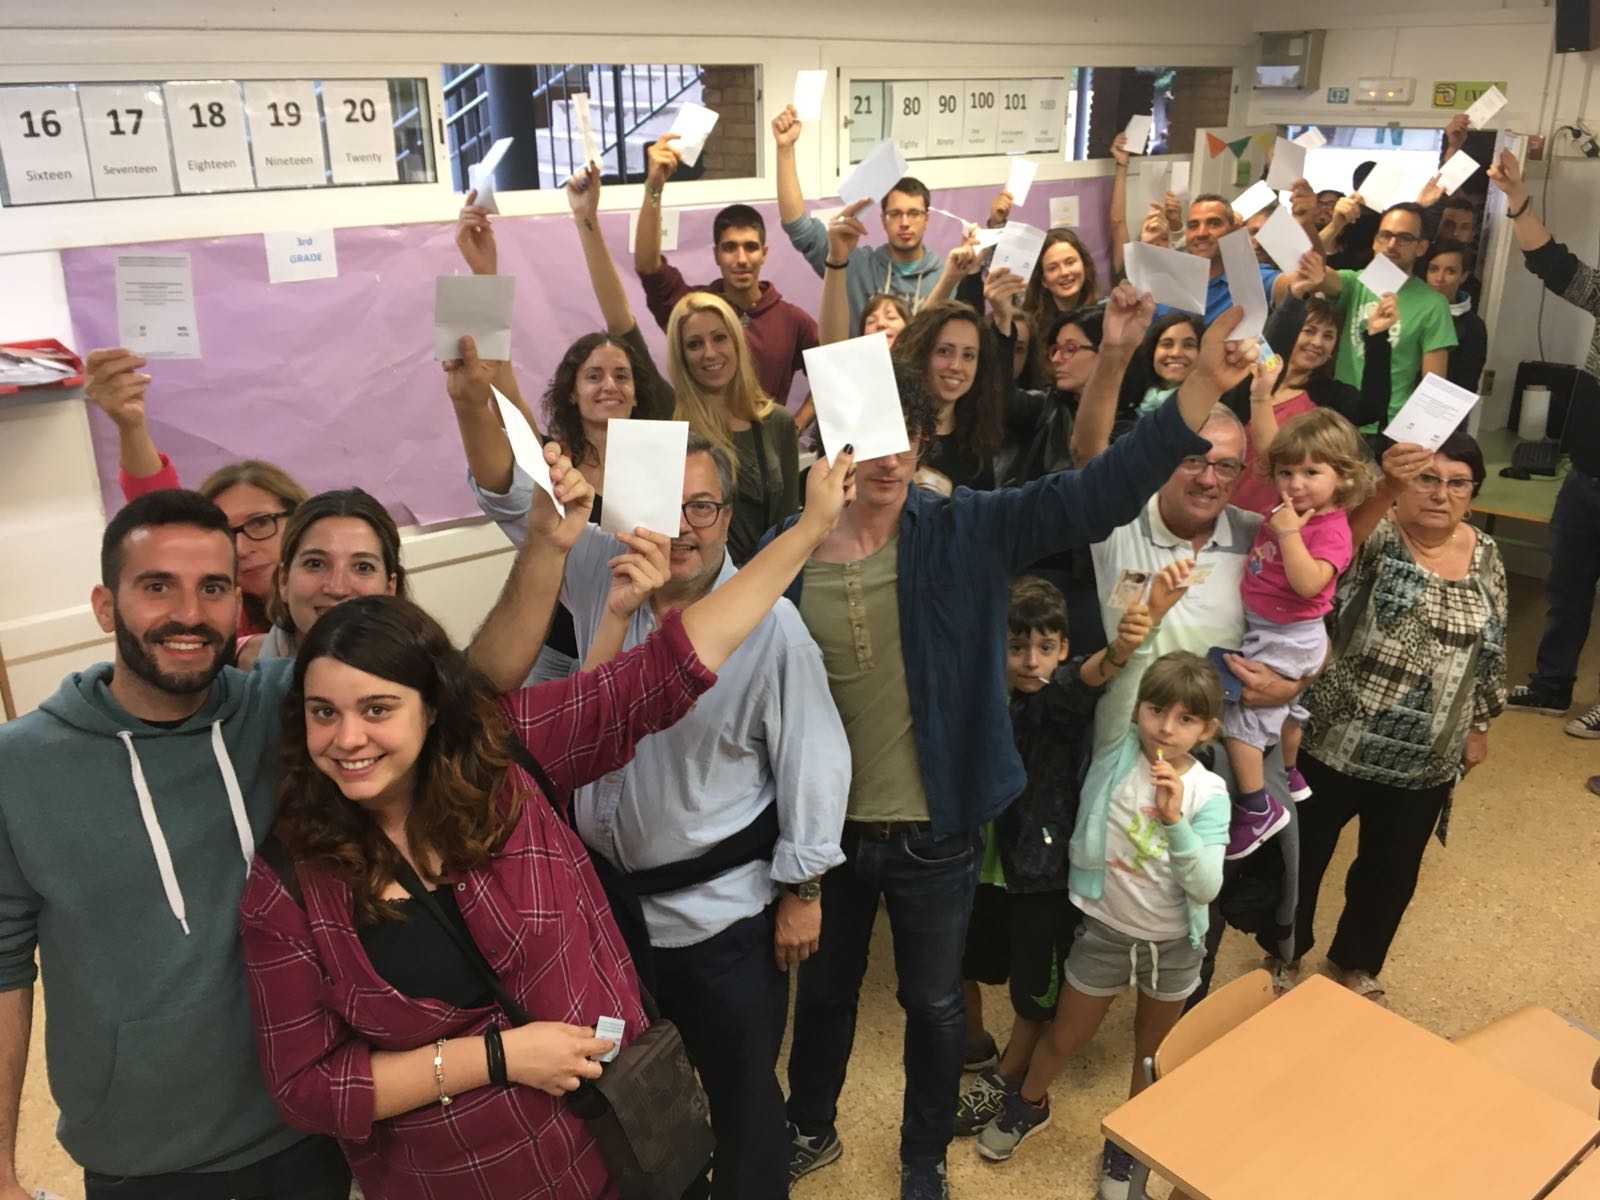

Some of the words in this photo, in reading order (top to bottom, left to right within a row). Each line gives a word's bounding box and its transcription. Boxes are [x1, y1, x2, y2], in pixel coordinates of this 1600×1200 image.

[853, 95, 873, 114] 21
[903, 97, 921, 116] 80
[938, 95, 957, 114] 90
[970, 92, 994, 109] 100
[1004, 94, 1027, 110] 101
[189, 101, 227, 128] 18
[267, 101, 301, 127] 19
[343, 98, 377, 123] 20
[19, 109, 62, 138] 16
[106, 108, 144, 136] 17
[187, 157, 237, 173] Eighteen
[265, 154, 314, 168] Nineteen
[345, 151, 383, 166] Twenty
[26, 168, 72, 181] Sixteen
[103, 163, 158, 176] Seventeen
[296, 236, 313, 246] 3rd
[289, 253, 323, 263] GRADE
